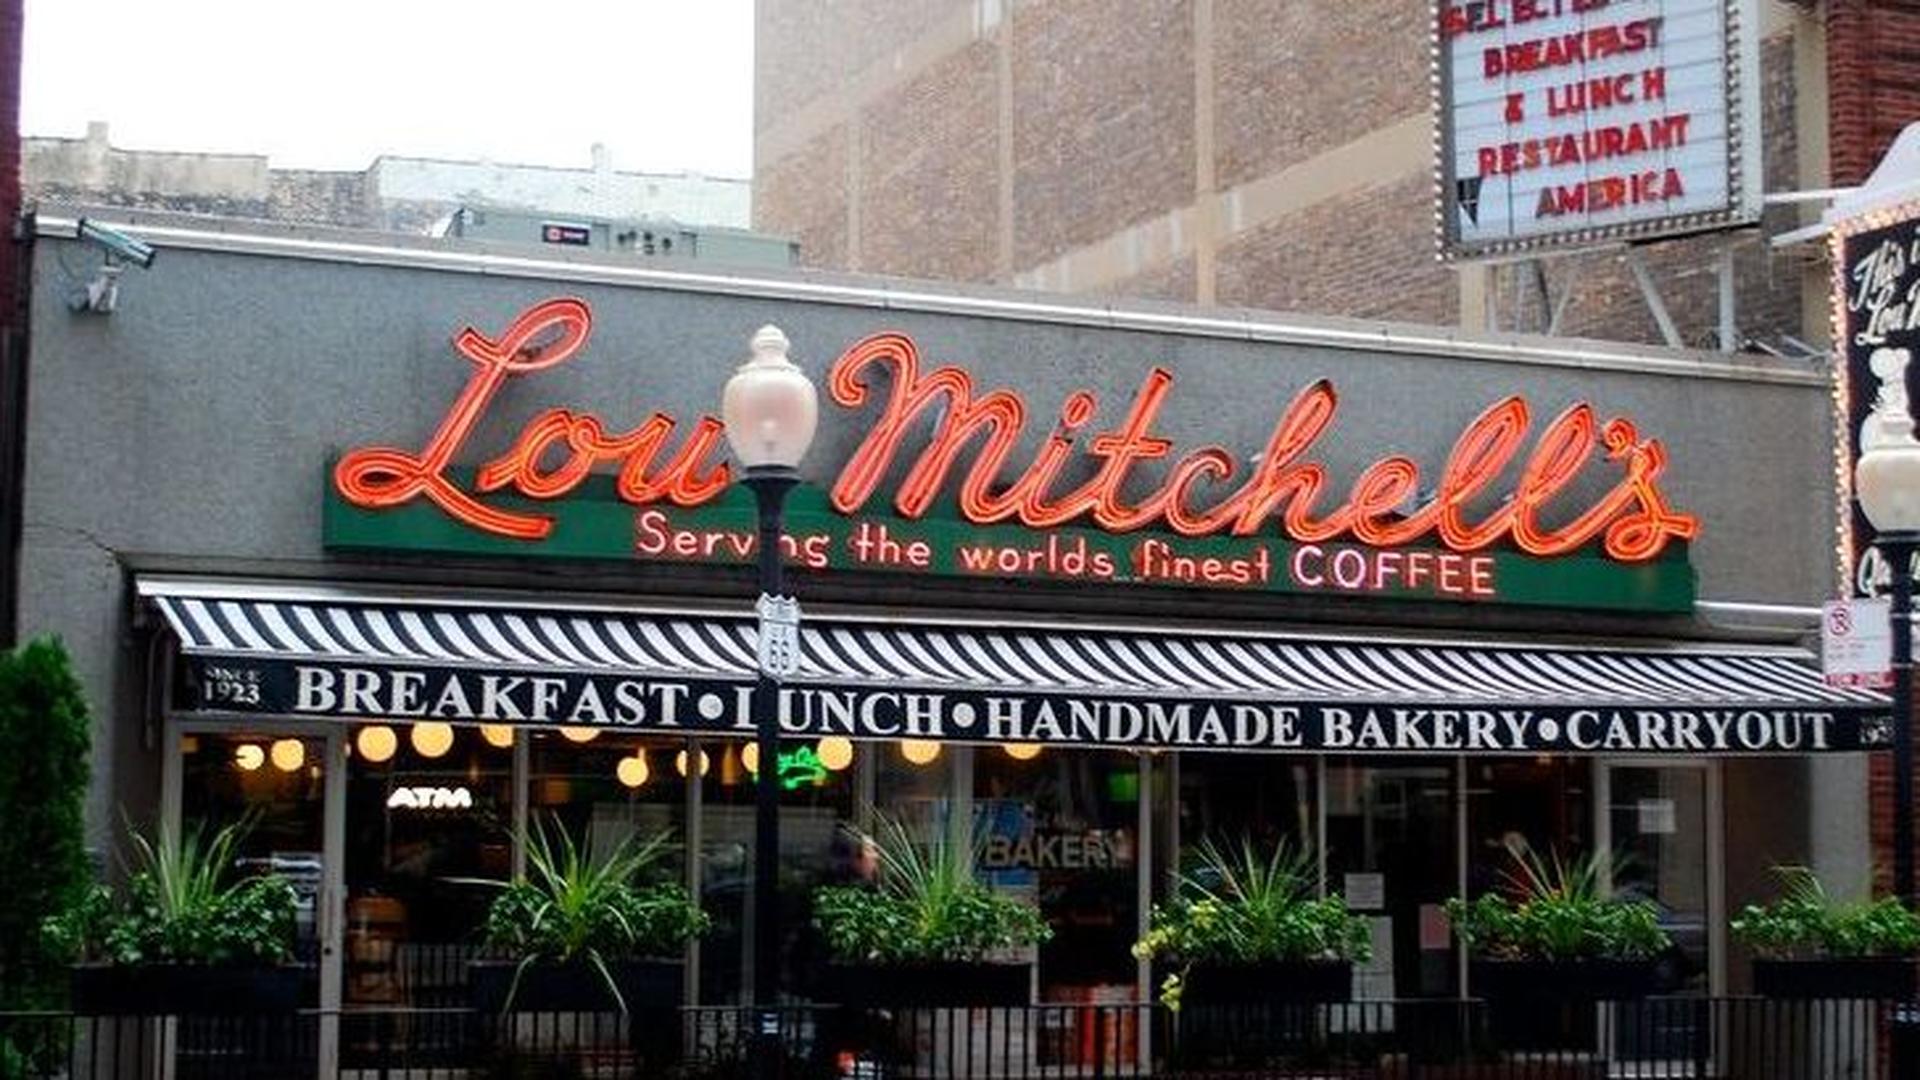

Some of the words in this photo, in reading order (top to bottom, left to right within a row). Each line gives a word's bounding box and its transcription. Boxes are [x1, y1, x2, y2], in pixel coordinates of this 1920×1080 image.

[1483, 18, 1662, 77] BREAKFAST
[1547, 68, 1665, 117] LUNCH
[1478, 114, 1690, 175] RESTAURANT
[1535, 168, 1683, 219] AMERICA
[334, 297, 729, 539] Lou
[829, 332, 1698, 562] Mitchell's
[637, 512, 829, 568] Servng
[855, 523, 931, 567] the
[961, 534, 1114, 579] worlds
[1137, 539, 1269, 583] finest
[1294, 545, 1496, 595] COFFEE
[204, 680, 260, 704] 1923
[295, 666, 688, 725] BREAKFAST
[735, 685, 947, 737] LUNCH
[984, 697, 1302, 746] HANDMADE
[1320, 708, 1534, 750] BAKERY
[1566, 709, 1834, 751] CARRYOUT
[386, 786, 473, 809] ATM
[985, 831, 1118, 869] BAKERY
